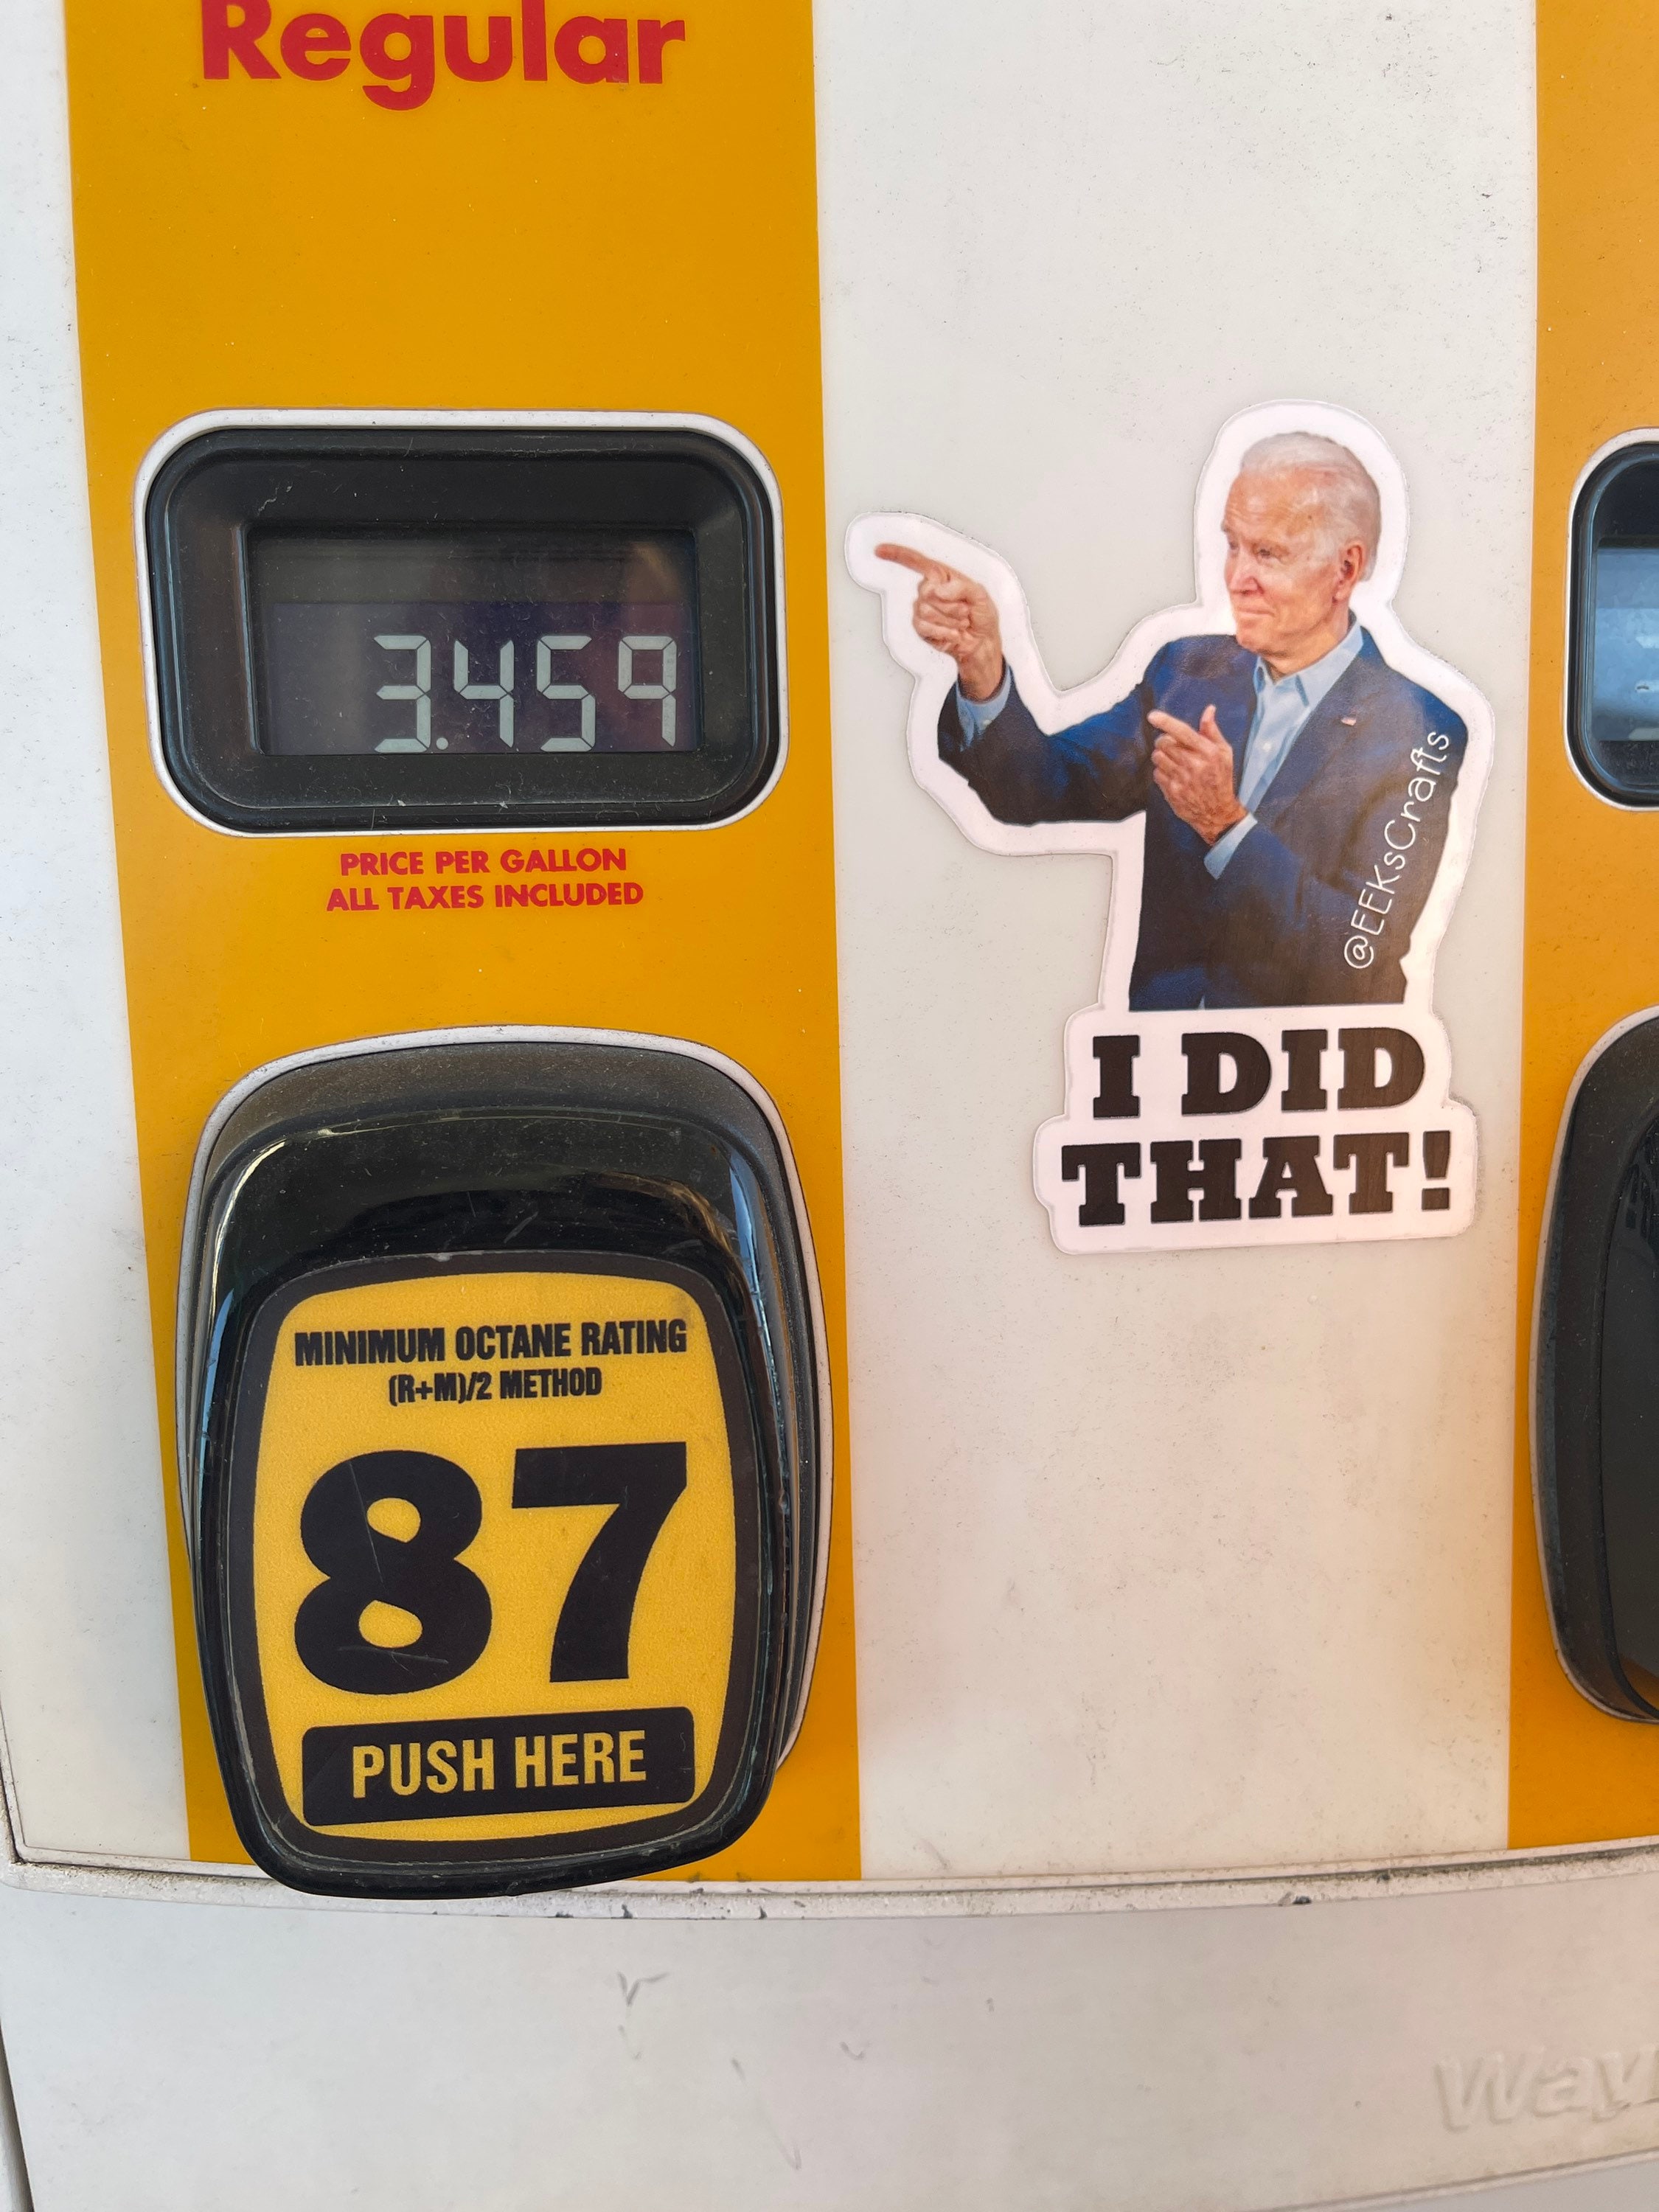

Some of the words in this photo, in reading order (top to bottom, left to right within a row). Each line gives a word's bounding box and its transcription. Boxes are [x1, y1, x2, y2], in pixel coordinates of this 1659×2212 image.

[201, 0, 686, 111] Regular
[374, 635, 677, 754] 3.459
[340, 852, 424, 876] PRICE
[436, 850, 490, 874] PER
[500, 848, 627, 872] GALLON
[1343, 730, 1451, 970] @EEKsCrafts
[326, 888, 379, 912] ALL
[386, 885, 484, 910] TAXES
[495, 882, 644, 908] INCLUDED
[1092, 1034, 1141, 1120] I
[1181, 1027, 1426, 1116] DID
[1061, 1130, 1452, 1227] THAT!
[295, 1327, 444, 1366] MINIMUM
[456, 1324, 571, 1361] OCTANE
[581, 1319, 687, 1357] RATING
[388, 1371, 492, 1407] (R+M)/2
[500, 1367, 602, 1399] METHOD
[295, 1441, 687, 1696] 87
[352, 1739, 495, 1798] PUSH
[515, 1730, 647, 1787] HERE
[1432, 2044, 1659, 2134] Way
